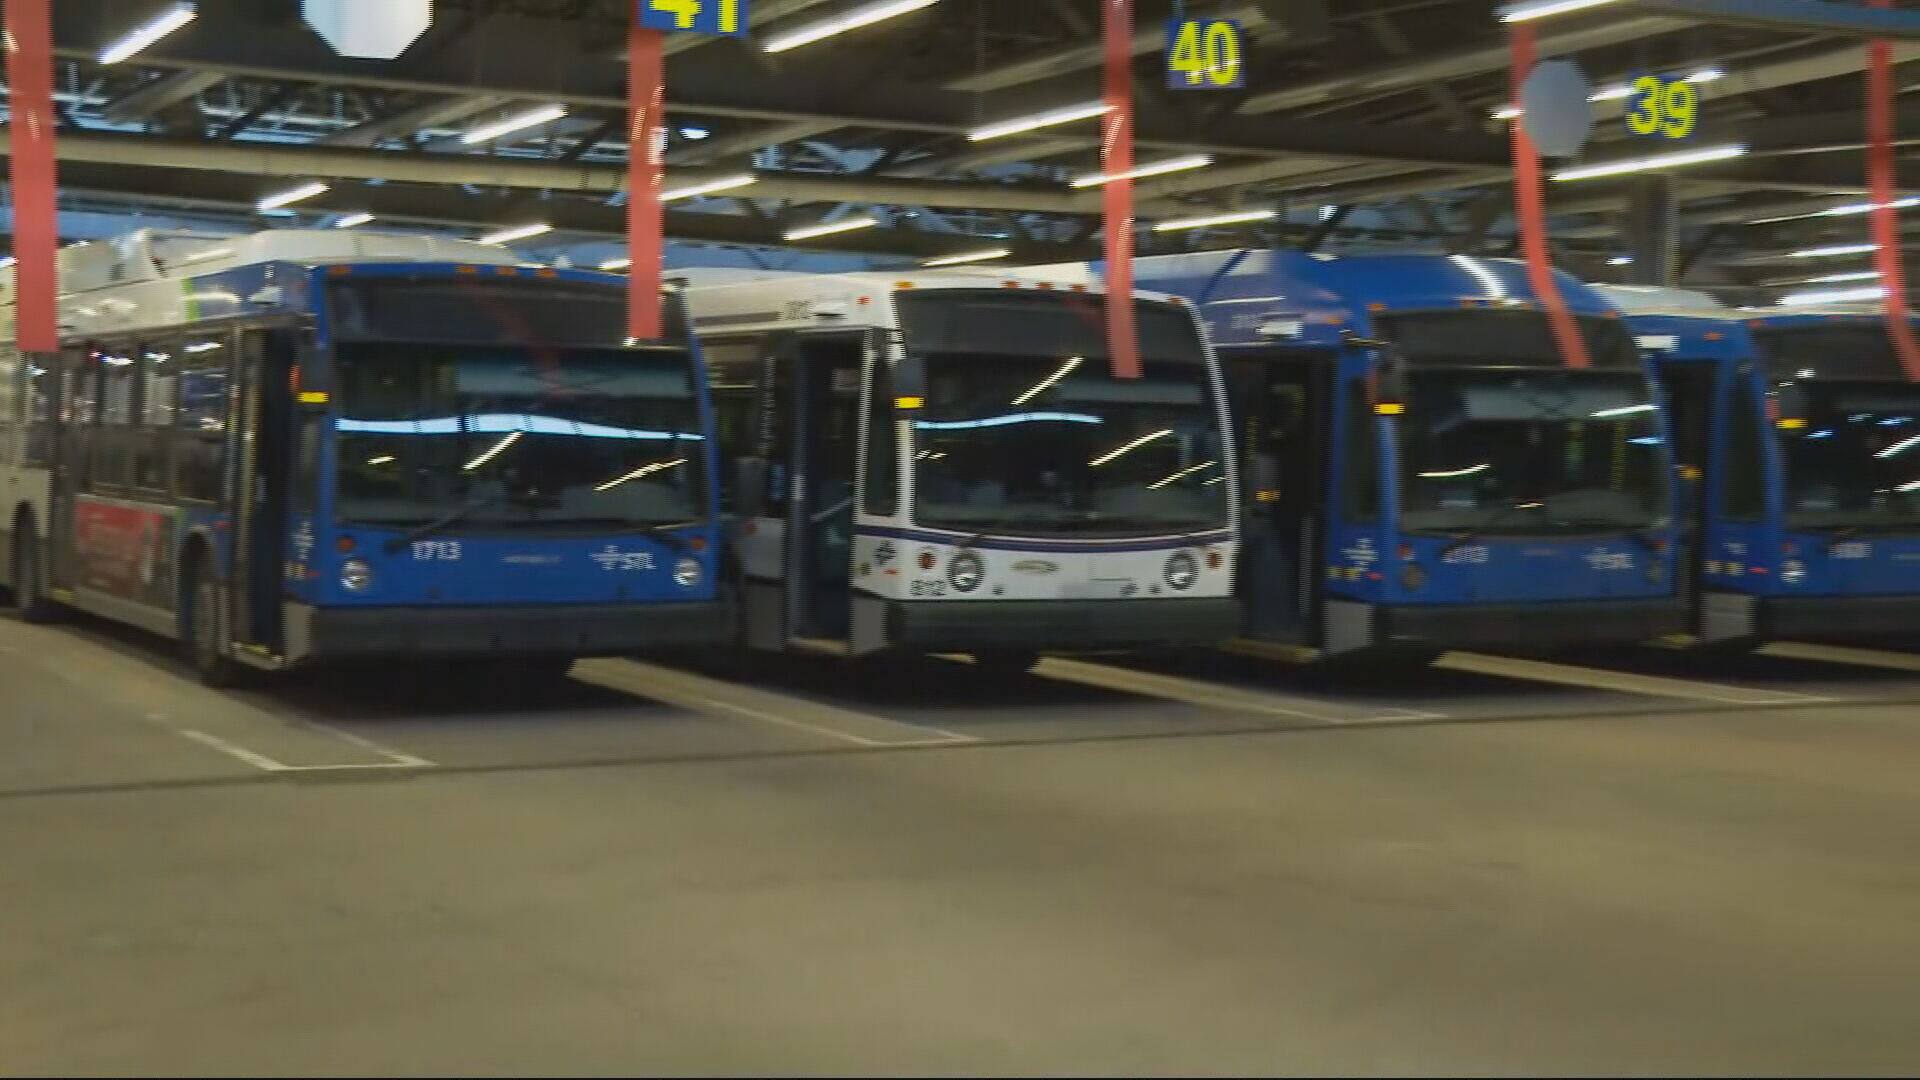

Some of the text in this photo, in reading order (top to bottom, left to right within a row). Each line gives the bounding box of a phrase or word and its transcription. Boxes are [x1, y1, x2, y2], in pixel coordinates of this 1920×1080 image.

[1168, 21, 1240, 85] 40
[1626, 75, 1698, 138] 39
[411, 541, 462, 560] 1713
[620, 553, 656, 569] STL
[910, 579, 946, 596] 812
